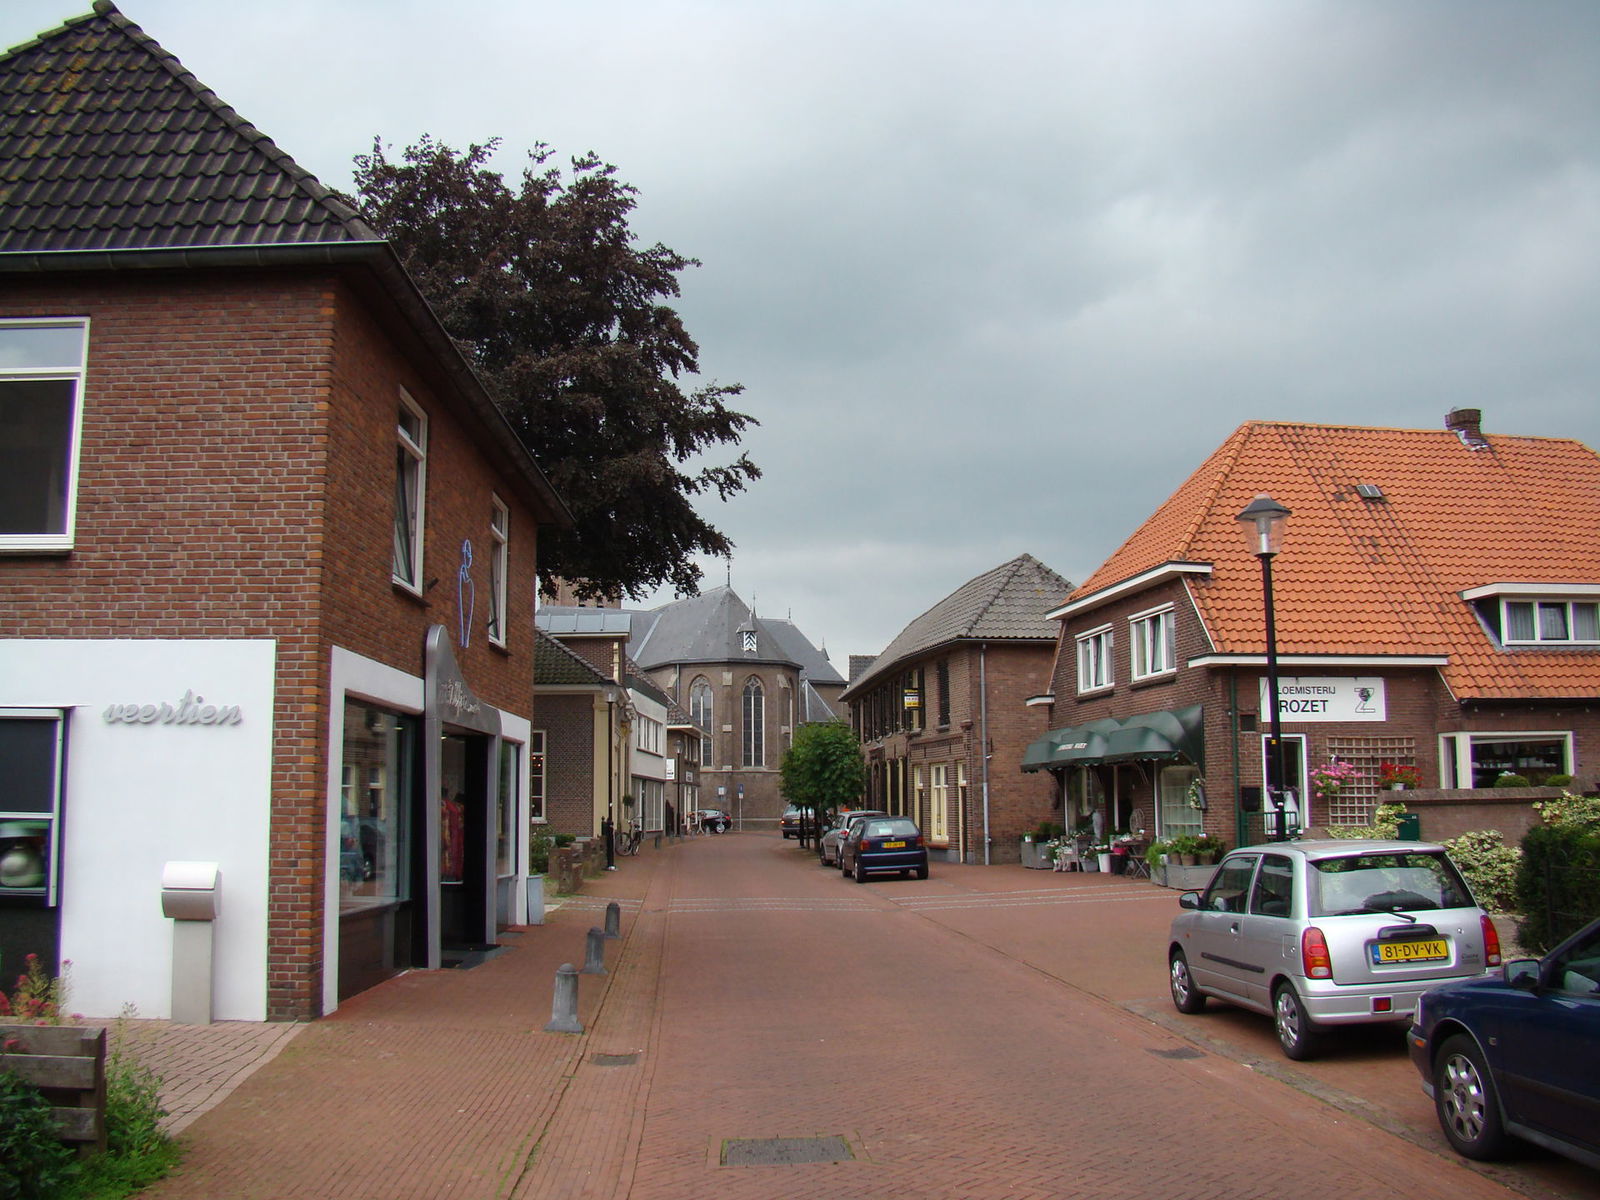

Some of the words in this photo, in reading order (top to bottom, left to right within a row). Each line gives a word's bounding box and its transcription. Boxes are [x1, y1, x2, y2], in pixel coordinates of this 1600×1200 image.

[1278, 686, 1336, 695] LOEMISTERIJ
[102, 688, 243, 725] veertien
[1279, 699, 1329, 713] ROZET
[1385, 943, 1442, 958] 81-DV-VK
